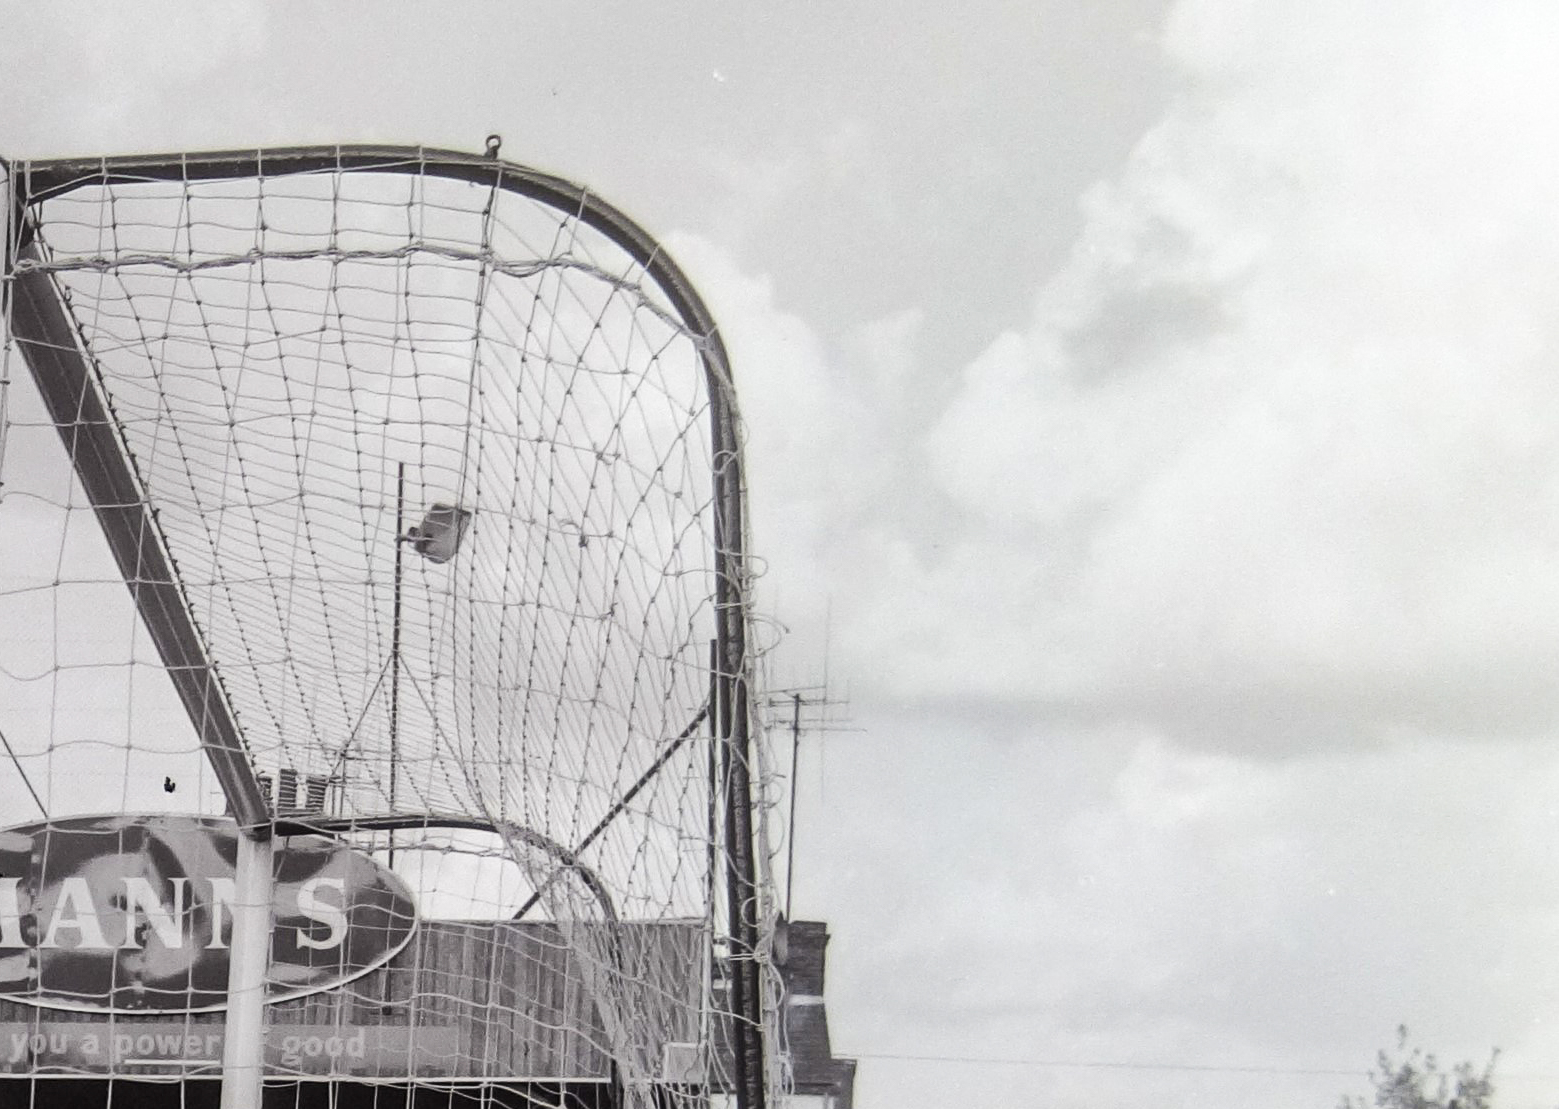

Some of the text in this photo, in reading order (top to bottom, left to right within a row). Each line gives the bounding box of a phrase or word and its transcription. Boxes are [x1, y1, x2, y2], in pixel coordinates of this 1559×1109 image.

[10, 1031, 68, 1063] you
[80, 1031, 101, 1055] a
[113, 1031, 222, 1062] power
[281, 1028, 366, 1066] good
